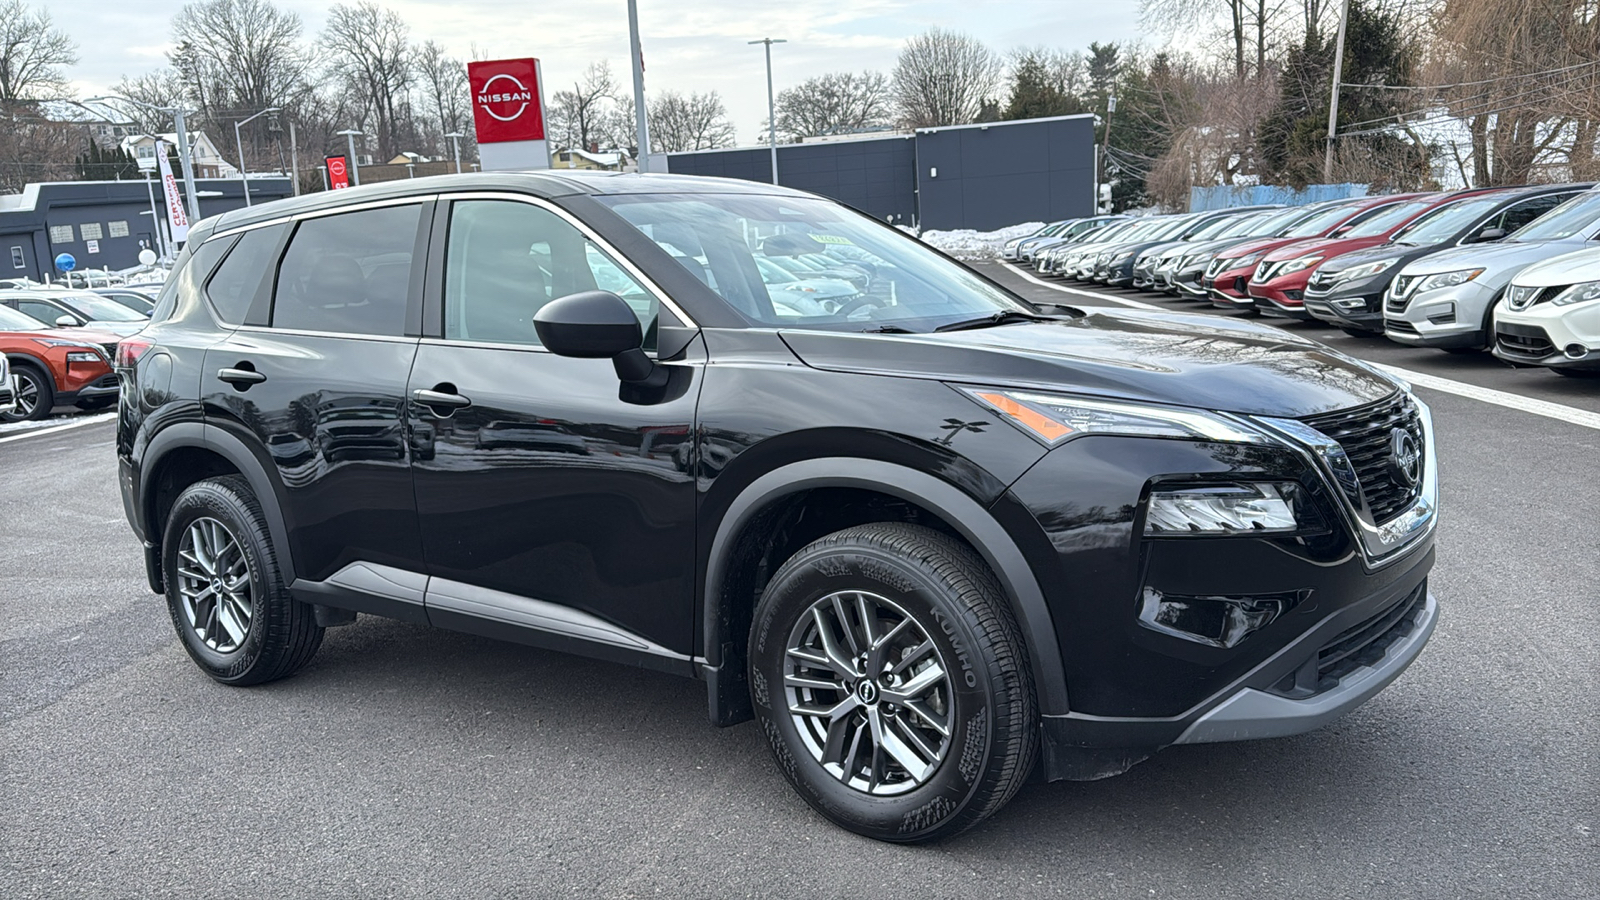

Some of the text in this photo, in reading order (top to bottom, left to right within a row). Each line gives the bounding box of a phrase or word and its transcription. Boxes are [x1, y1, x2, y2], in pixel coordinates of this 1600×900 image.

[478, 92, 531, 103] NISSAN
[166, 174, 181, 226] CERTIFIED
[237, 530, 259, 582] KUMHO
[929, 605, 977, 688] KUMHO
